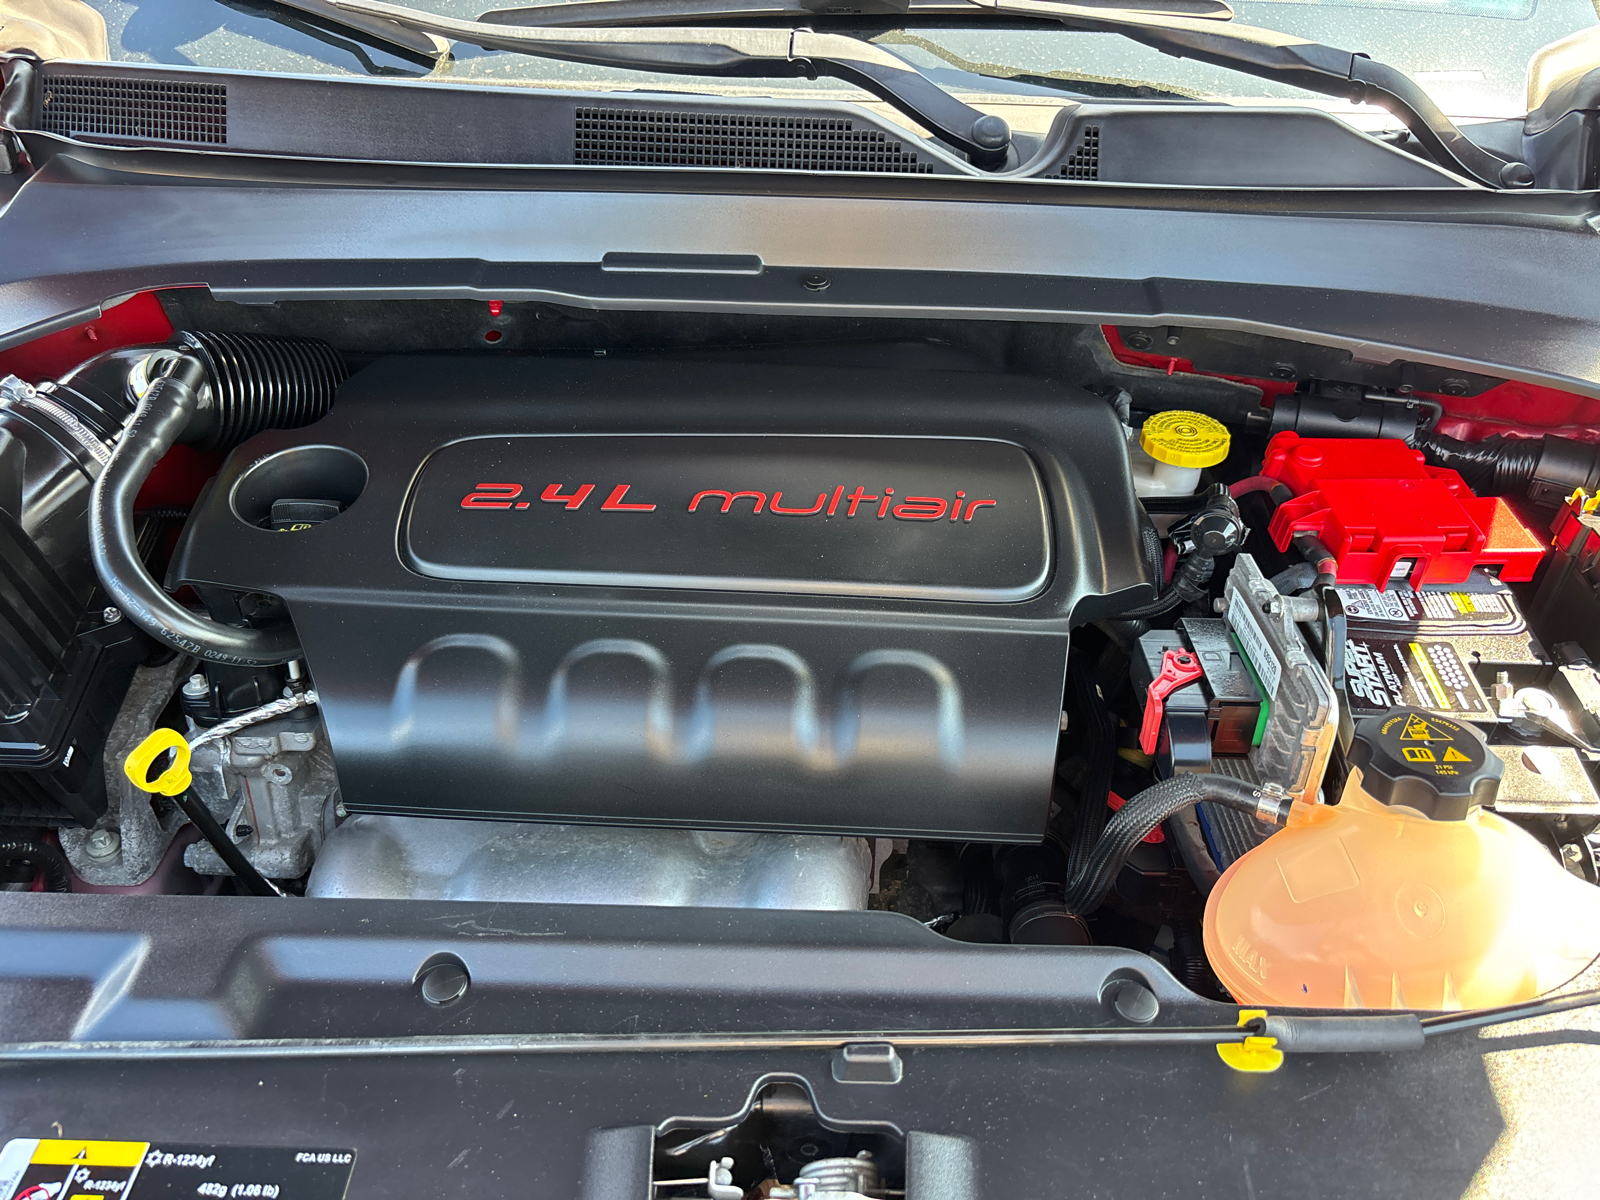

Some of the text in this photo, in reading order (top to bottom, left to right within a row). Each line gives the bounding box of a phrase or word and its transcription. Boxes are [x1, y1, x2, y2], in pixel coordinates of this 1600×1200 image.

[460, 483, 998, 523] 2.4L multiair
[1354, 644, 1392, 708] START
[1373, 651, 1407, 707] PLATINUM
[162, 1152, 216, 1169] R-1234yf
[294, 1152, 352, 1165] FCA US LLC
